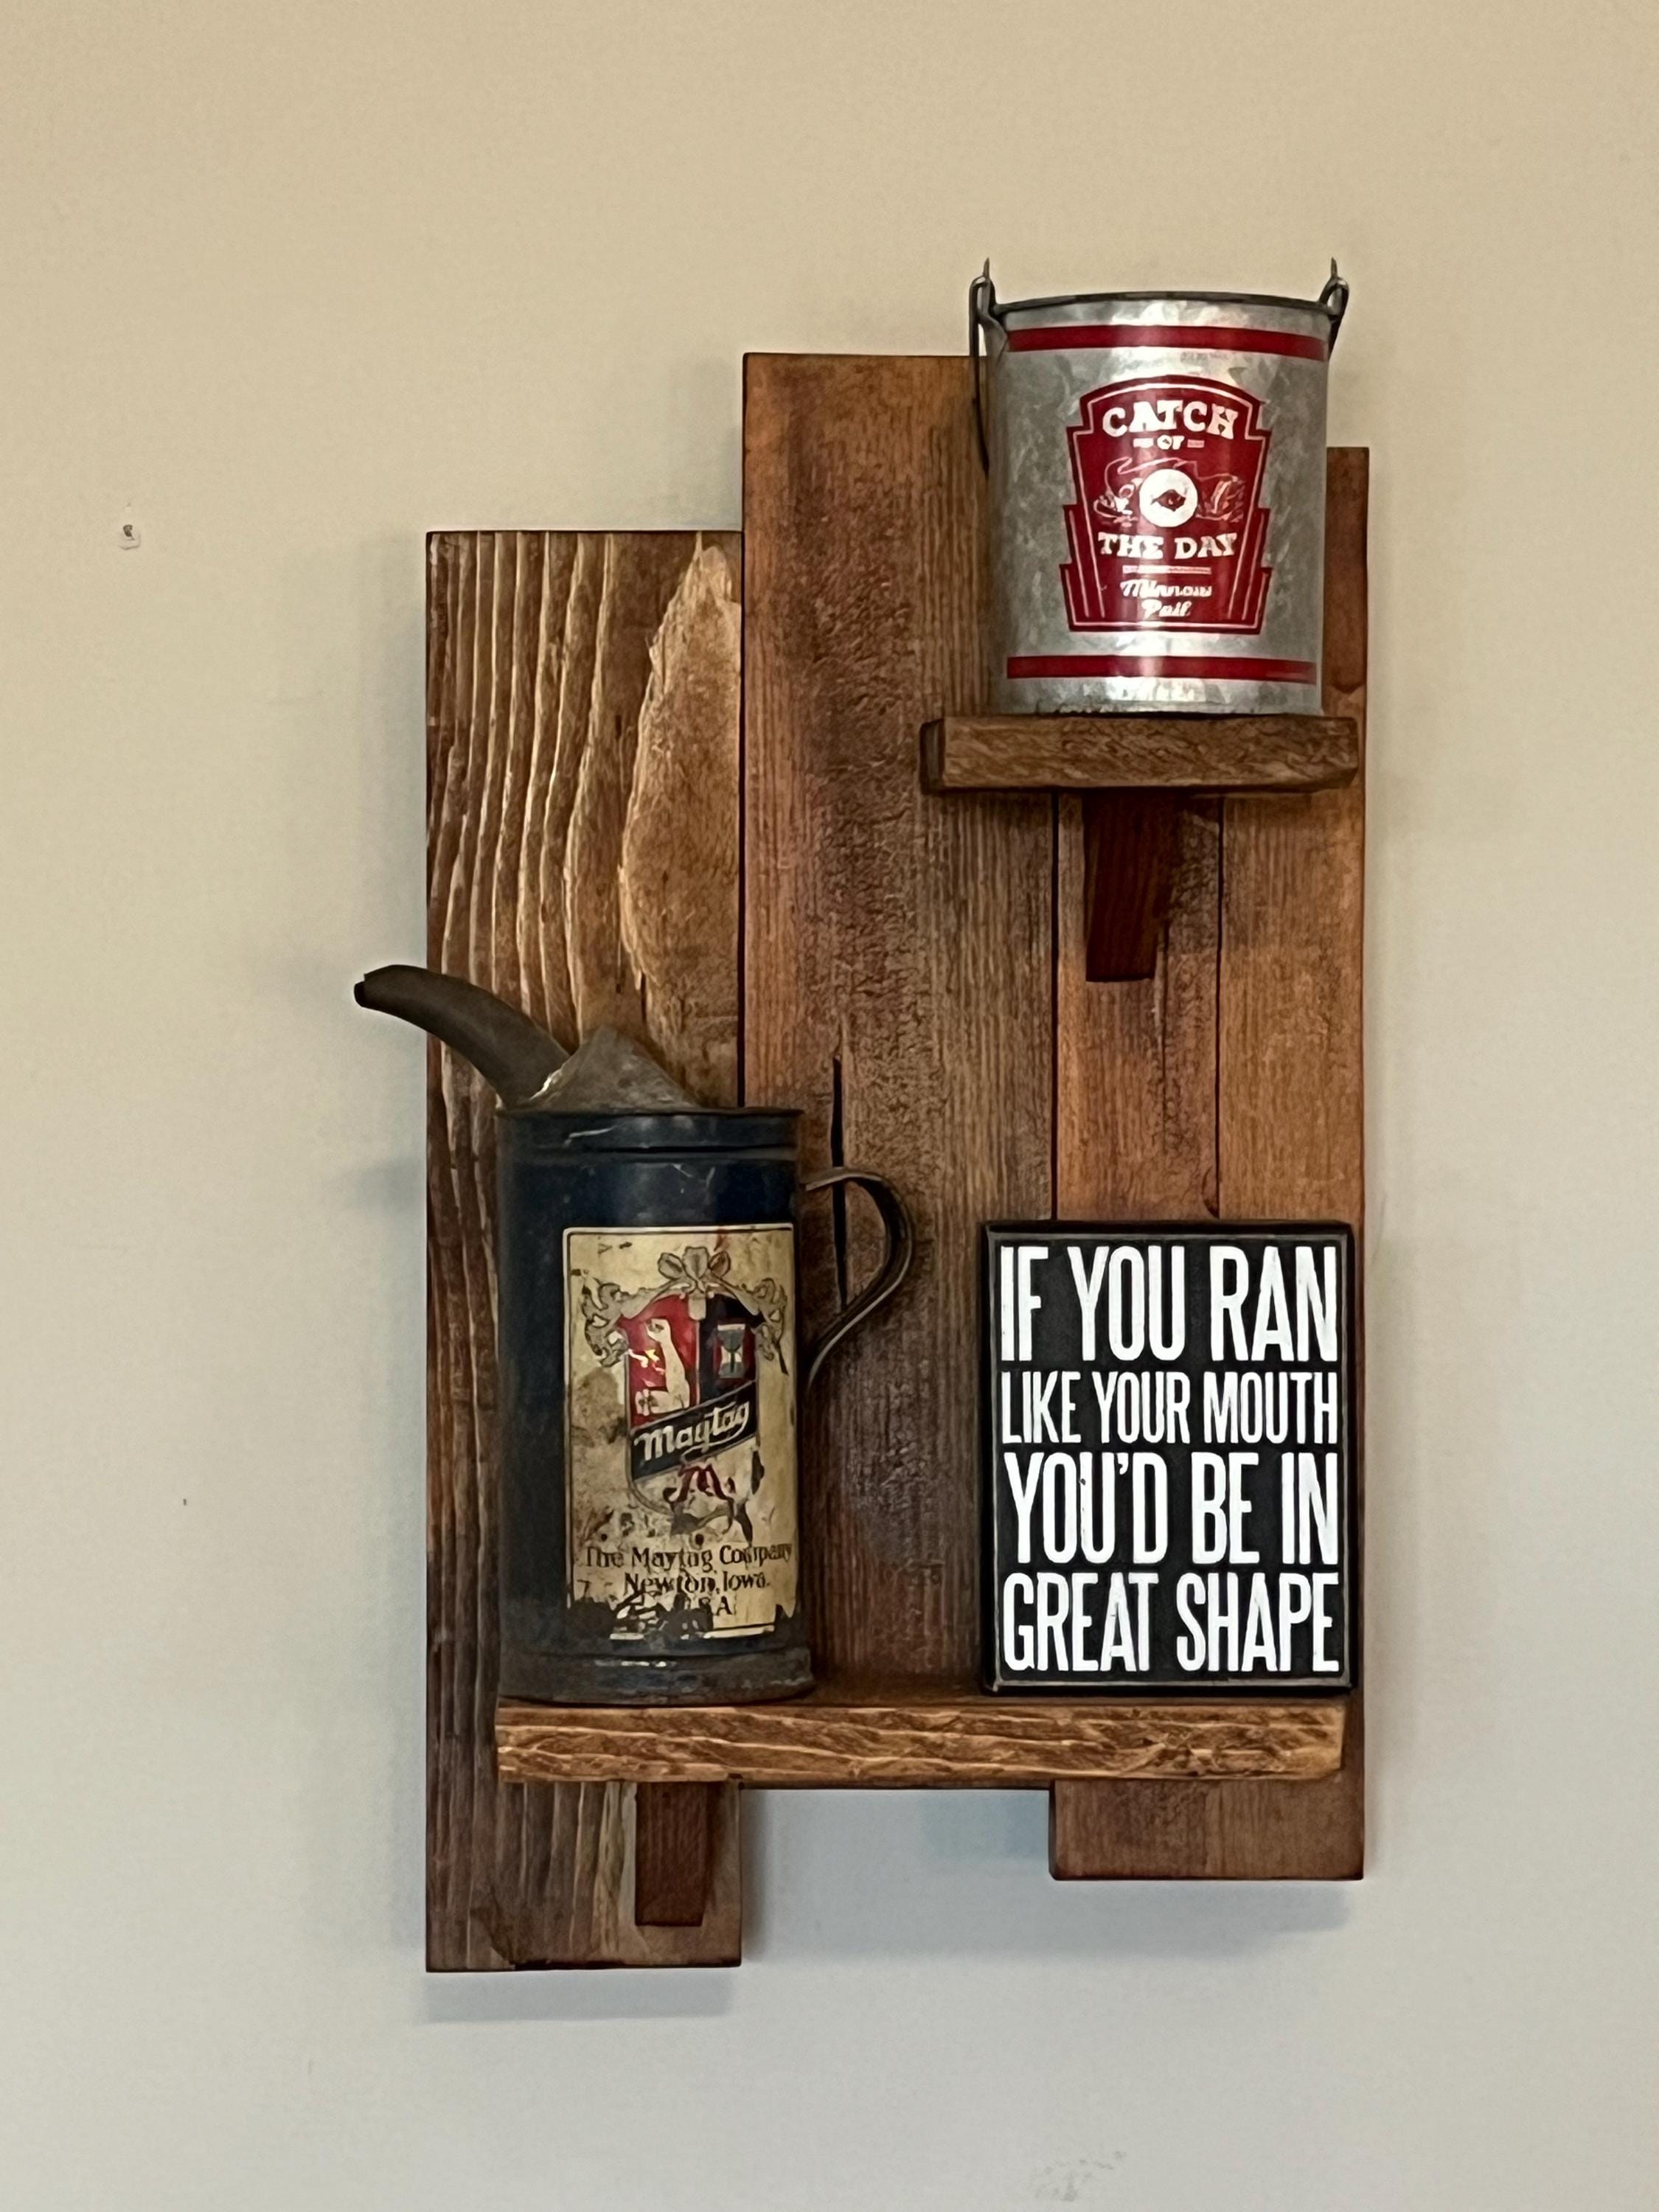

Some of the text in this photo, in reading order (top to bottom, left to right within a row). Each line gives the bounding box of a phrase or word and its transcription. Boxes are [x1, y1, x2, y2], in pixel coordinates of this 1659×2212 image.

[1102, 400, 1238, 439] CATCH
[1157, 434, 1185, 450] OF
[1098, 532, 1237, 560] THE DAY
[1001, 1245, 1337, 1361] IF YOU RAN
[633, 1401, 750, 1464] Maytag
[1001, 1371, 1337, 1444] LIKE YOUR MOUTH
[1004, 1452, 1338, 1565] YOU'D BE IN
[585, 1543, 793, 1573] The Maytag Company
[1004, 1572, 1340, 1672] GREAT SHAPE
